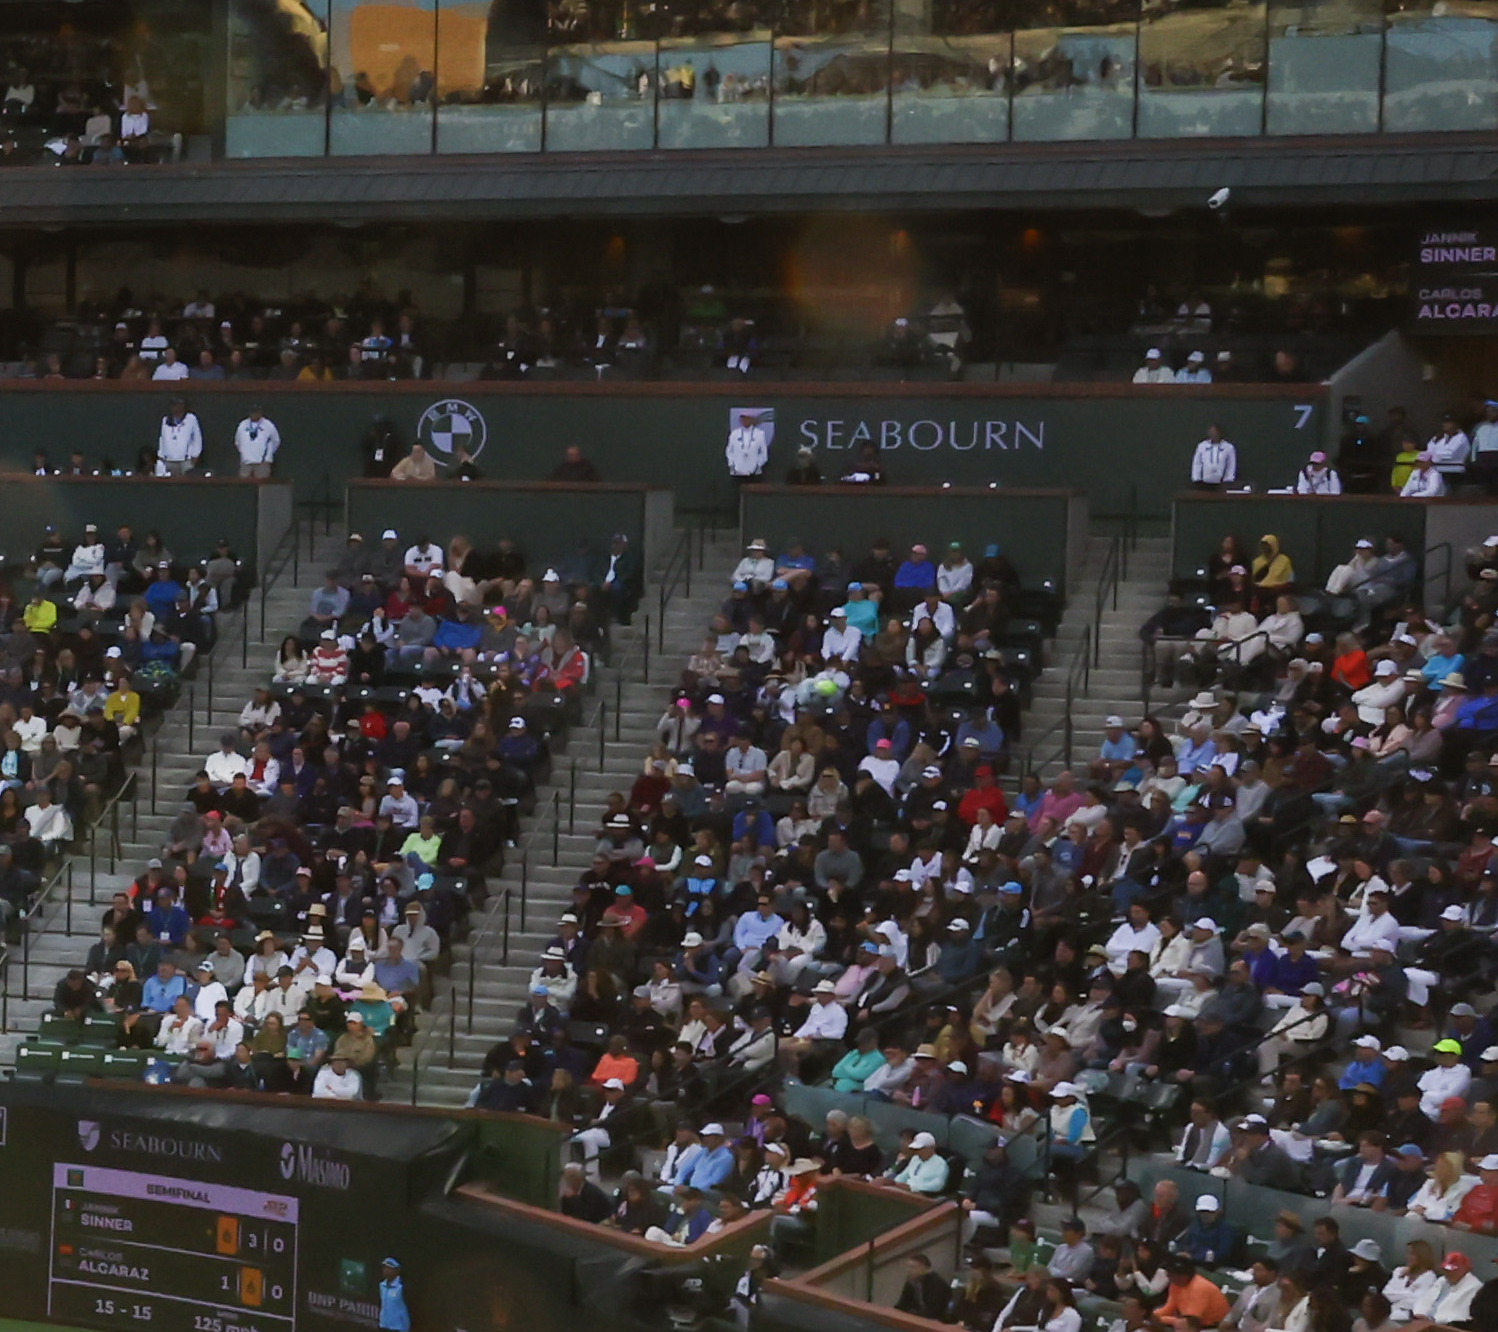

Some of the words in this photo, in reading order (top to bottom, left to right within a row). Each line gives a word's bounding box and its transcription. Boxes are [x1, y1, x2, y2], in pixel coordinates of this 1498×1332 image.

[1420, 247, 1496, 263] SINNER
[1294, 404, 1312, 428] 7
[799, 419, 1045, 451] SEABOURN
[111, 1130, 222, 1162] SEABOURN
[146, 1184, 210, 1203] SEMIFINAL
[80, 1214, 133, 1232] SINNER
[248, 1234, 257, 1248] 3
[79, 1260, 150, 1280] ALCARAZ
[221, 1275, 230, 1290] 1
[95, 1299, 114, 1315] 15
[132, 1305, 152, 1321] 15
[194, 1316, 222, 1332] 125
